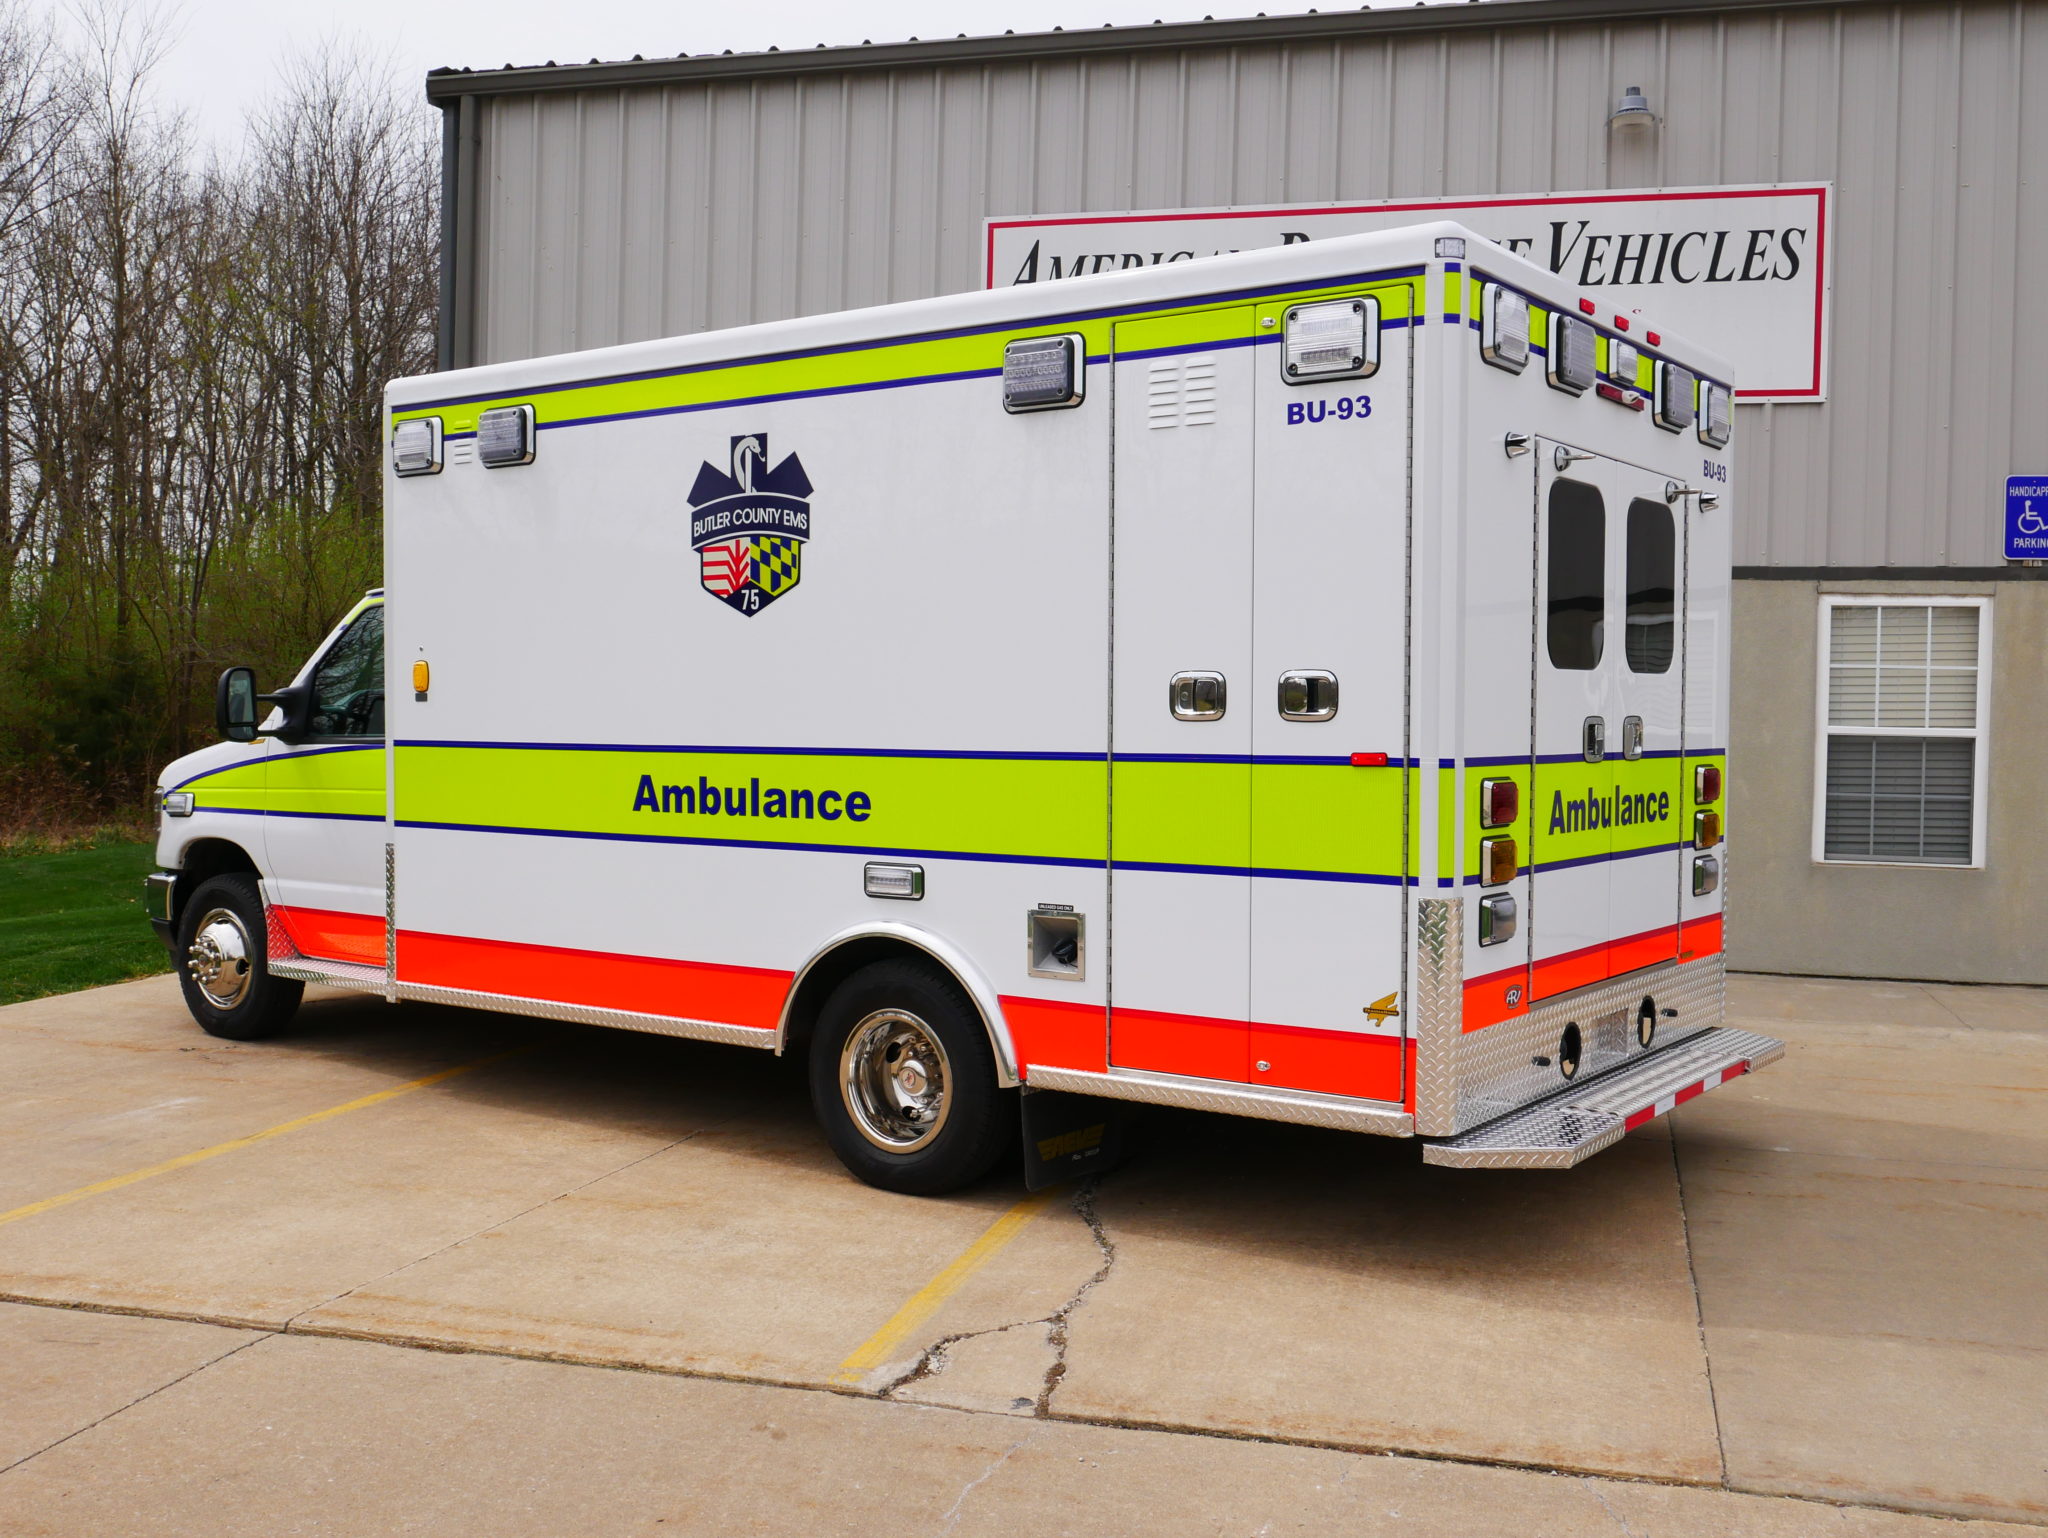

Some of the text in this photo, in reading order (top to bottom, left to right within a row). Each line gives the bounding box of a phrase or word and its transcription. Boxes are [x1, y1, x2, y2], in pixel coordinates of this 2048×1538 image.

[1549, 220, 1807, 286] VEHICLES
[1287, 395, 1372, 425] BU-93
[1703, 459, 1727, 483] BU-93
[693, 507, 808, 537] BUTLER COUNTY EMS
[2013, 537, 2048, 548] PARKIN
[741, 589, 760, 610] 75
[632, 774, 872, 822] Ambulance
[1548, 785, 1669, 836] Ambulance
